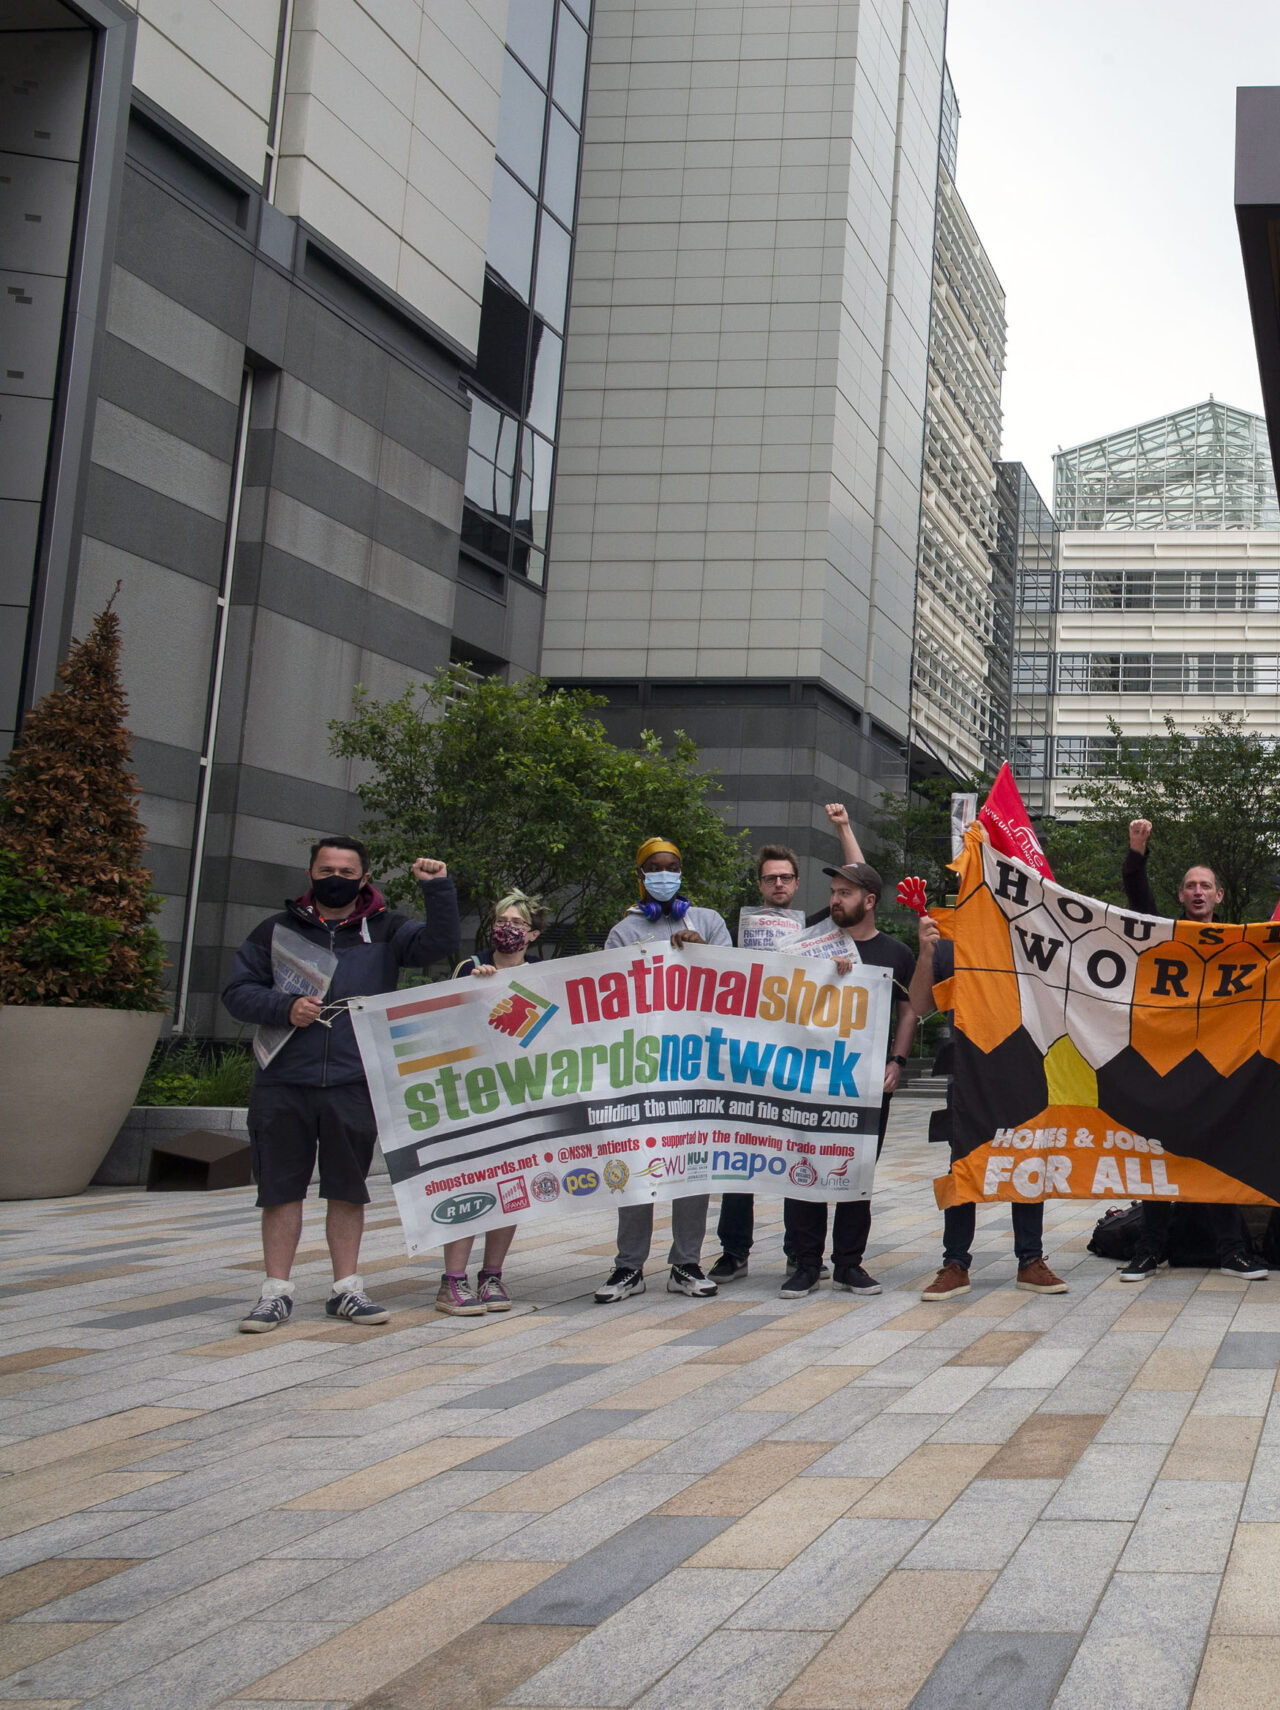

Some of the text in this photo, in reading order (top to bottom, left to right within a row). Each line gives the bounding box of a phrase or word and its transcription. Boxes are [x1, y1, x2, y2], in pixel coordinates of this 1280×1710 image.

[759, 918, 800, 930] Socialist
[588, 1096, 858, 1128] building the union rank and file since 2006
[991, 1127, 1165, 1155] HOMES & JOBS
[425, 1154, 539, 1196] shopstewards.net
[558, 1137, 640, 1164] @NSSN_anticuts
[661, 1131, 696, 1149] supported
[698, 1130, 708, 1146] by
[712, 1130, 731, 1143] the
[735, 1131, 783, 1151] following
[786, 1139, 816, 1155] trade
[820, 1144, 855, 1157] unions
[648, 1155, 686, 1178] CWU
[688, 1151, 708, 1165] NUJ
[712, 1151, 787, 1180] napo
[567, 1171, 598, 1195] pcs
[821, 1177, 850, 1187] unite
[983, 1155, 1179, 1198] FOR ALL
[447, 1199, 482, 1217] RMT
